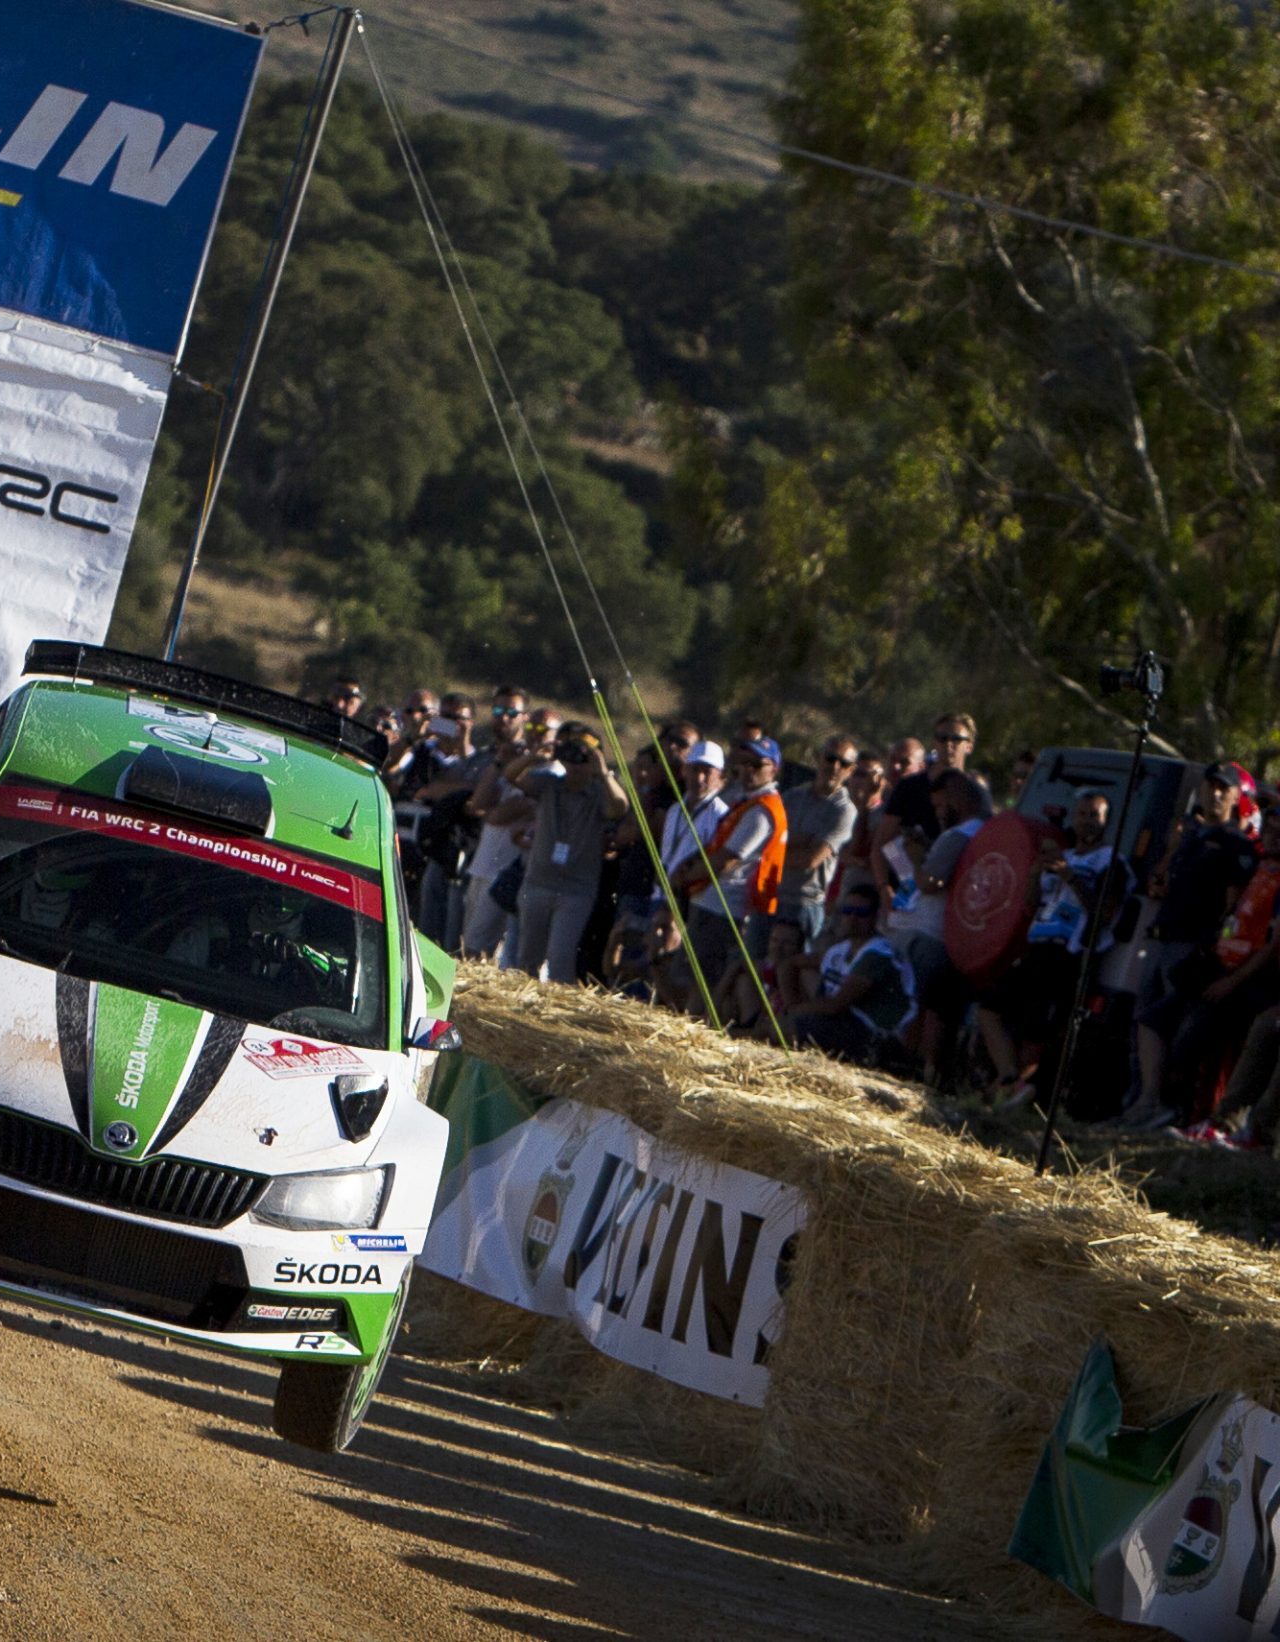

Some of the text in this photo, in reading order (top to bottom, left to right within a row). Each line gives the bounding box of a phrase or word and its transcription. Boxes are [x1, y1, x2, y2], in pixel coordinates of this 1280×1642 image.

[70, 806, 288, 873] FIA WRC 2 Championship
[114, 1000, 161, 1110] ŠKODA Motorsport
[357, 1238, 406, 1249] MICHELIN
[273, 1257, 382, 1285] ŠKODA
[256, 1305, 338, 1321] Castrol EDGE
